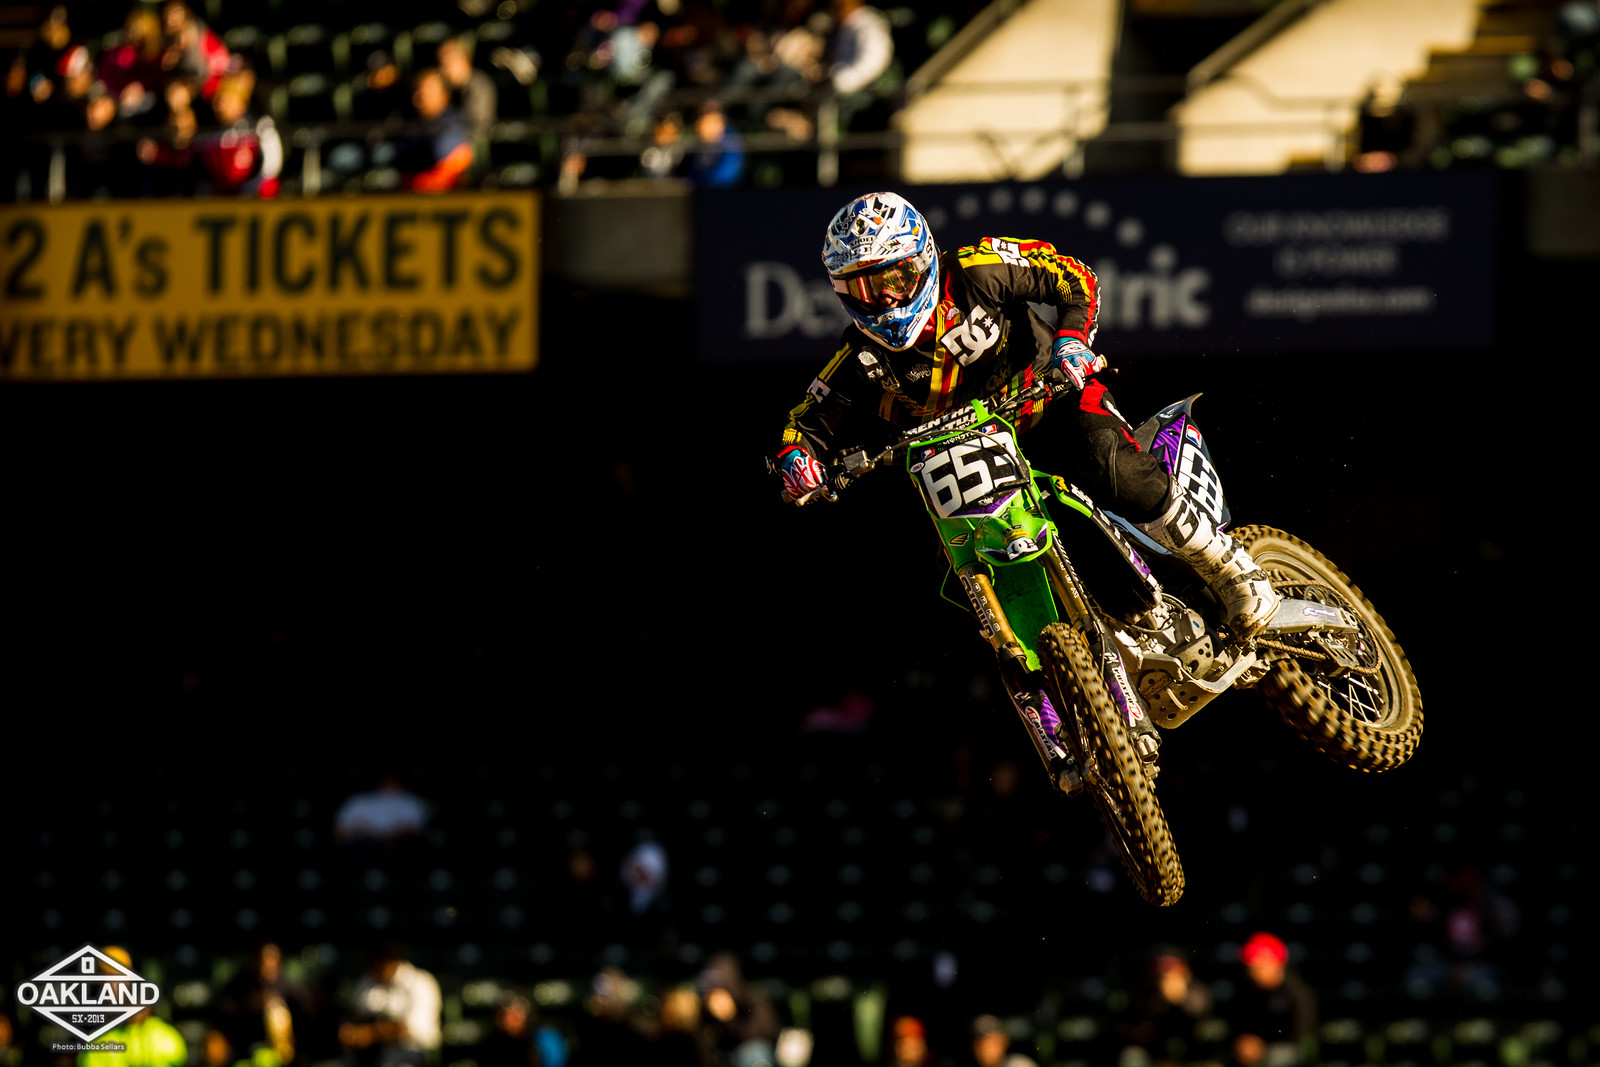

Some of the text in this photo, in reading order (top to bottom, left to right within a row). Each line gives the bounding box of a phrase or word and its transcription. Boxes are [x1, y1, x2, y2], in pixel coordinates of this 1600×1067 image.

[4, 217, 48, 299] 2
[193, 206, 522, 296] TICKETS
[152, 307, 520, 365] WEDNESDAY
